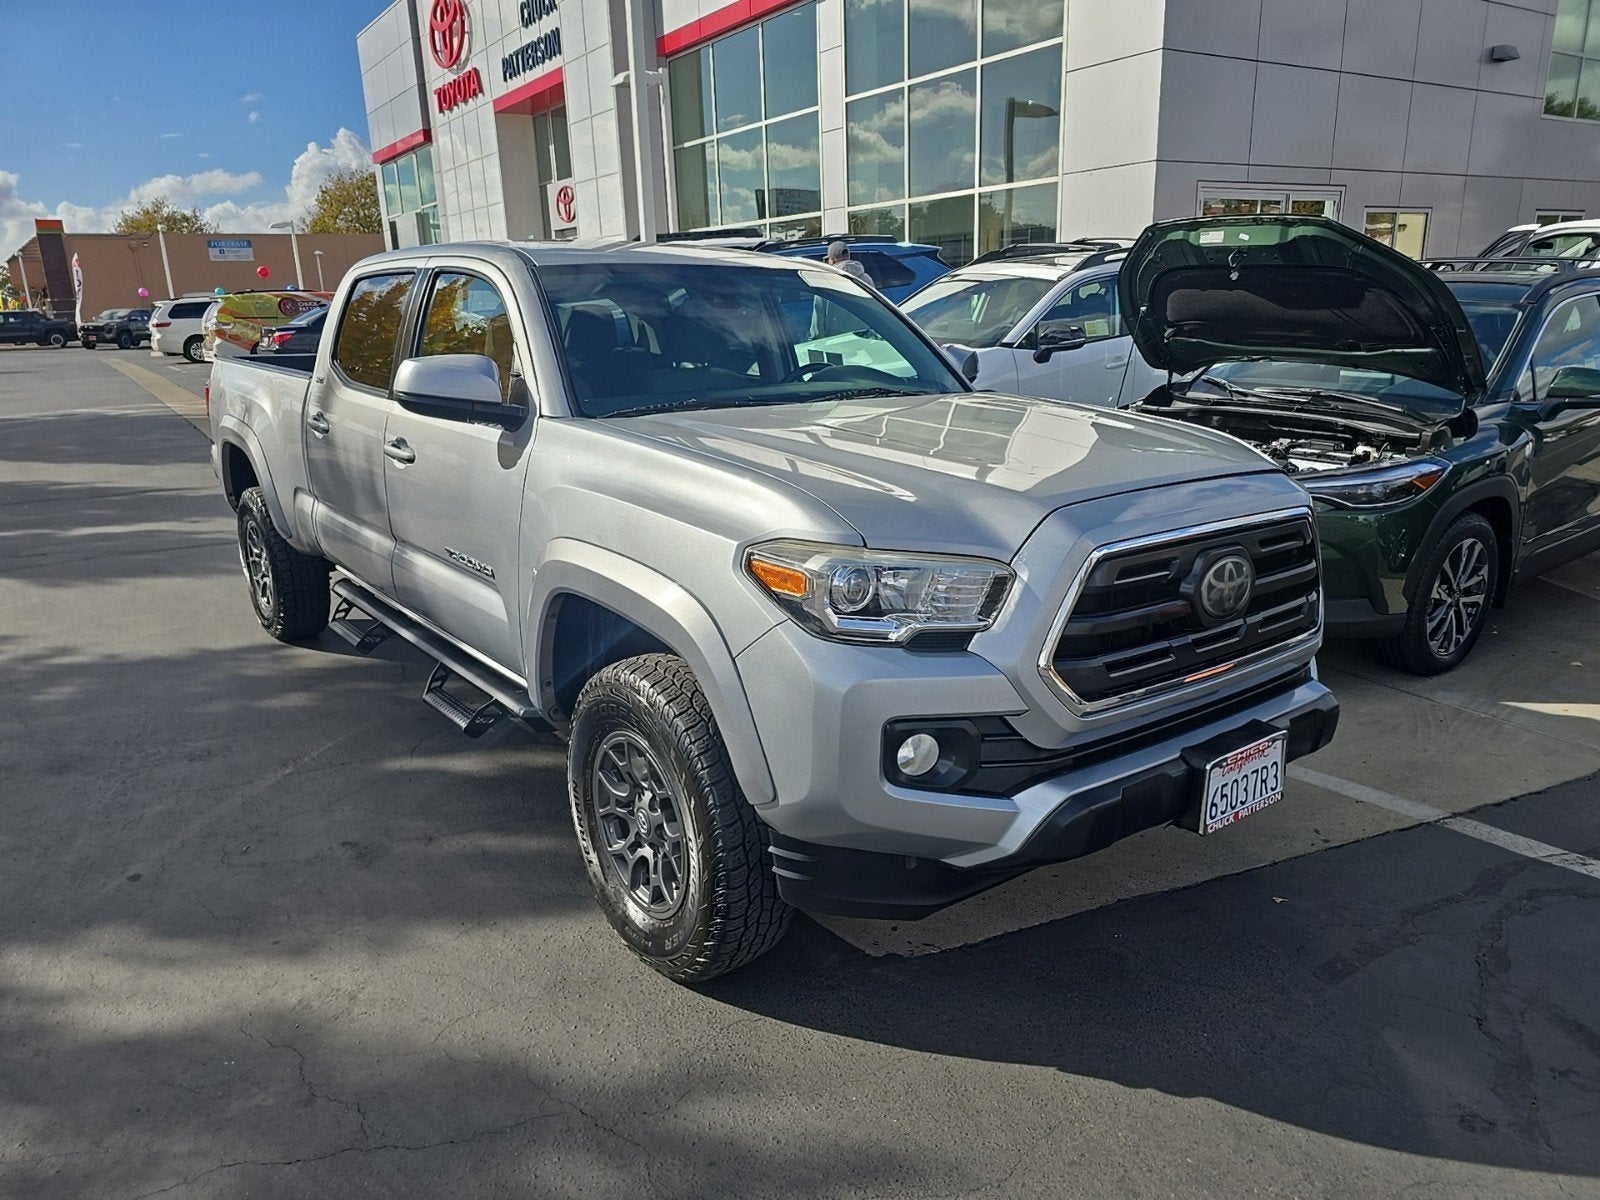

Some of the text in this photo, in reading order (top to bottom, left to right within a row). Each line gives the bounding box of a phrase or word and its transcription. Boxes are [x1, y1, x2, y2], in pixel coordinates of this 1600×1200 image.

[502, 26, 562, 83] PATTERSON
[434, 67, 484, 114] TOYOTA
[1227, 741, 1269, 764] CHICO
[1207, 792, 1282, 833] CHUCK PATTERSON
[1209, 760, 1279, 821] 65037R3
